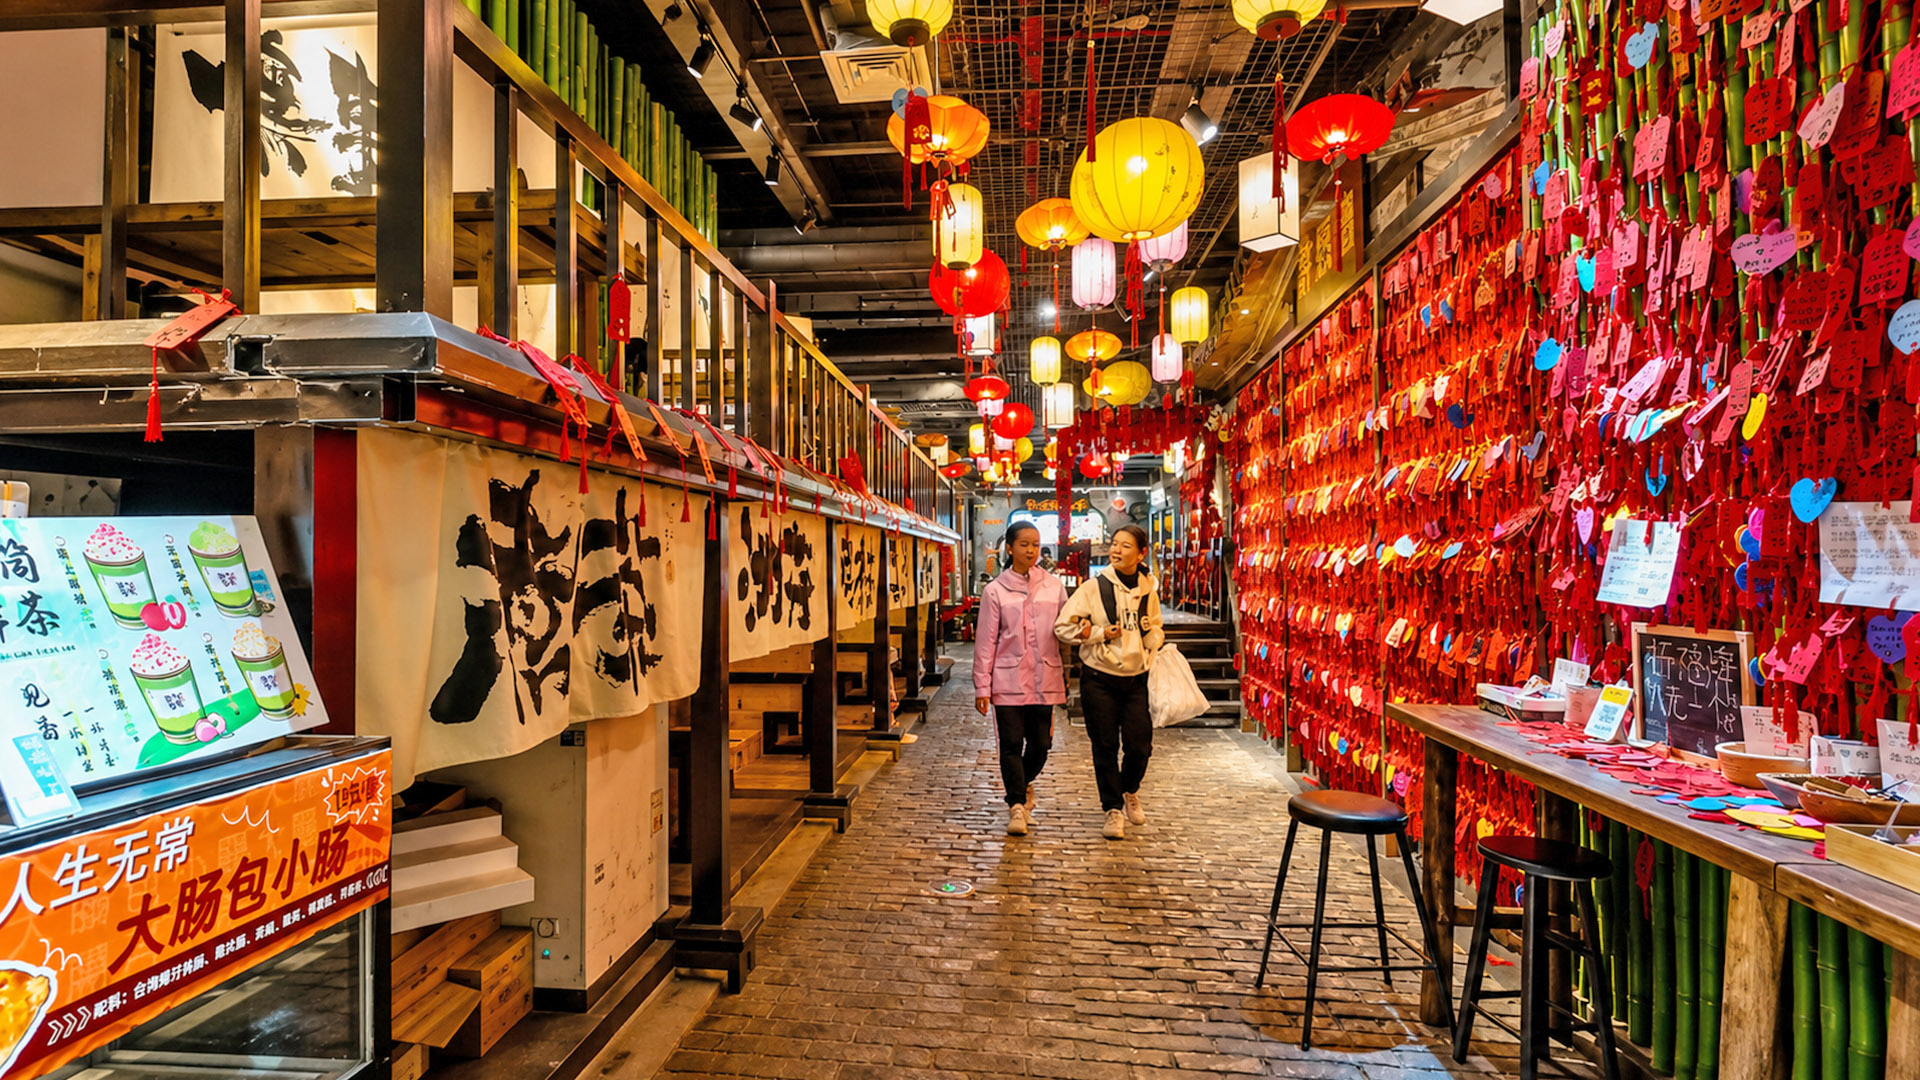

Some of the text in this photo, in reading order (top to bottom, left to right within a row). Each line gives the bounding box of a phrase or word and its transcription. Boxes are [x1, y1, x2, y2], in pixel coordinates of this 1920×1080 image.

[0, 816, 196, 925] 人生无常
[107, 820, 351, 975] 大肠包小肠
